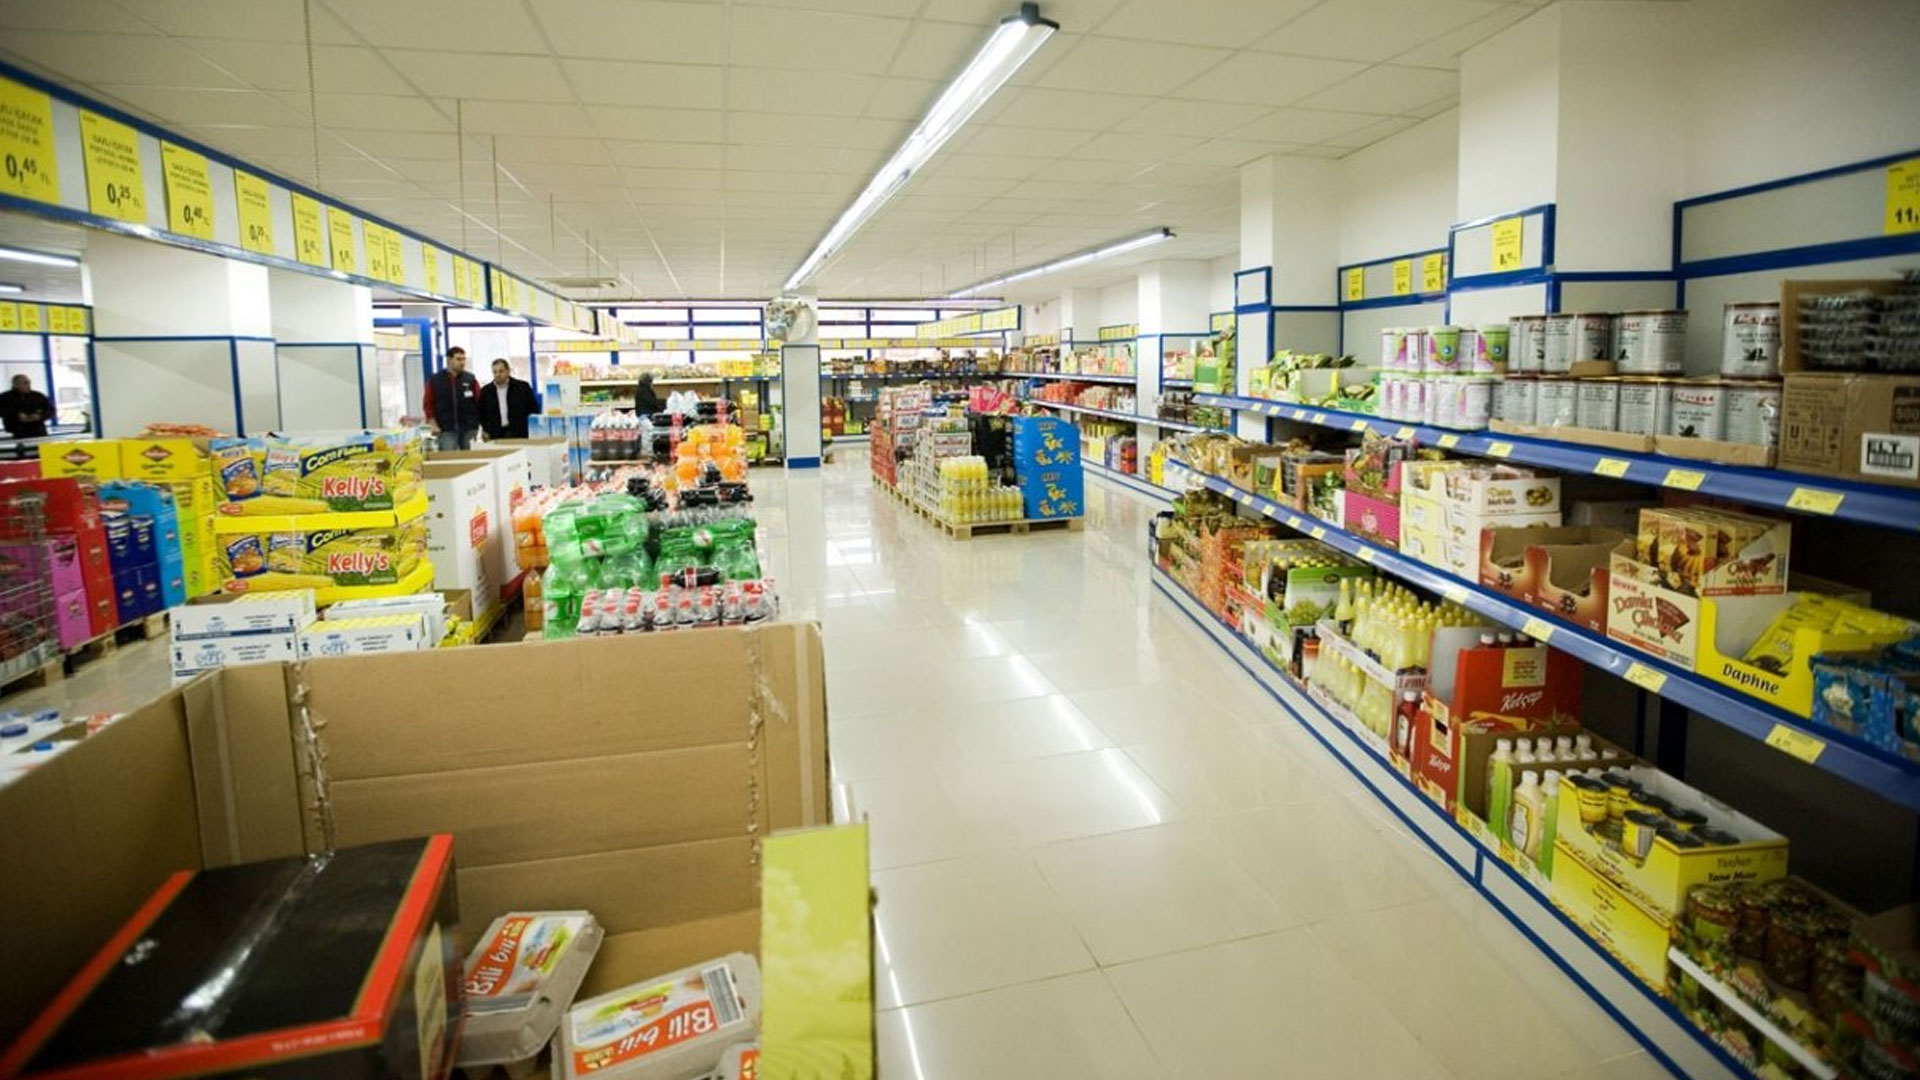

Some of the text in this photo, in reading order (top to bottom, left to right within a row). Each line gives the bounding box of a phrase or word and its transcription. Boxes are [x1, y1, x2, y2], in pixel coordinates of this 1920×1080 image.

[323, 477, 384, 500] Kelly's
[328, 551, 389, 576] Kelly's
[1722, 662, 1780, 696] Daphne
[489, 938, 517, 963] bili
[617, 1007, 715, 1055] Bili bili
